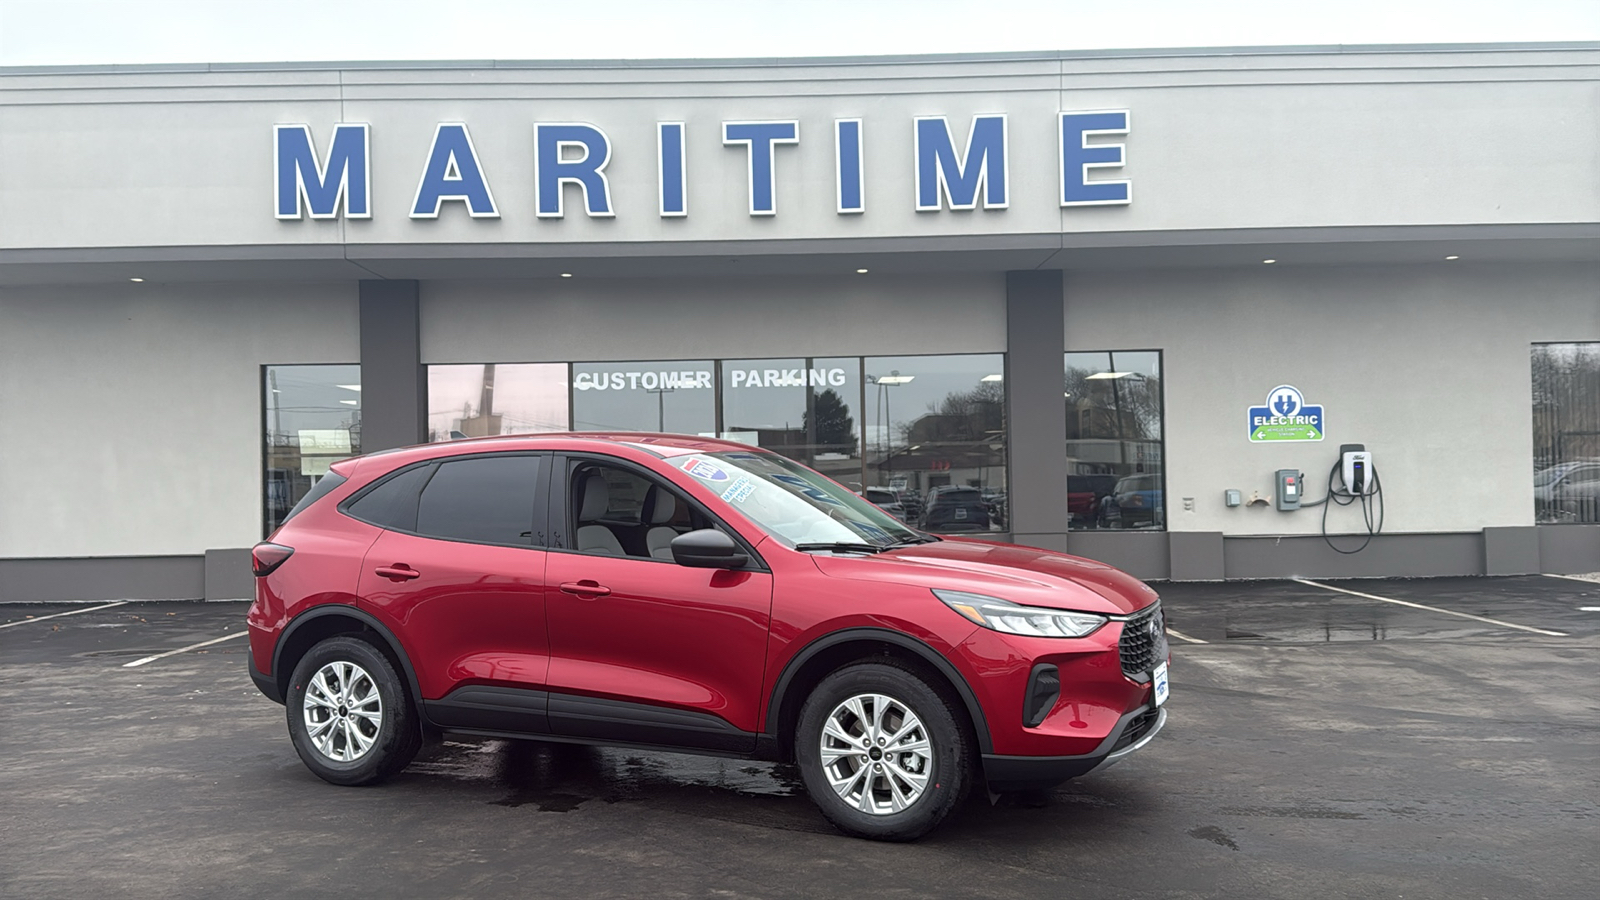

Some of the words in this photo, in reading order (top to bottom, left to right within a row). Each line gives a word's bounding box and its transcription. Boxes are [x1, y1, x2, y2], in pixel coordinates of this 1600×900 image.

[273, 108, 1133, 221] MARITIME
[575, 370, 712, 391] CUSTOMER
[731, 368, 846, 388] PARKING
[1254, 415, 1318, 426] ELECTRIC
